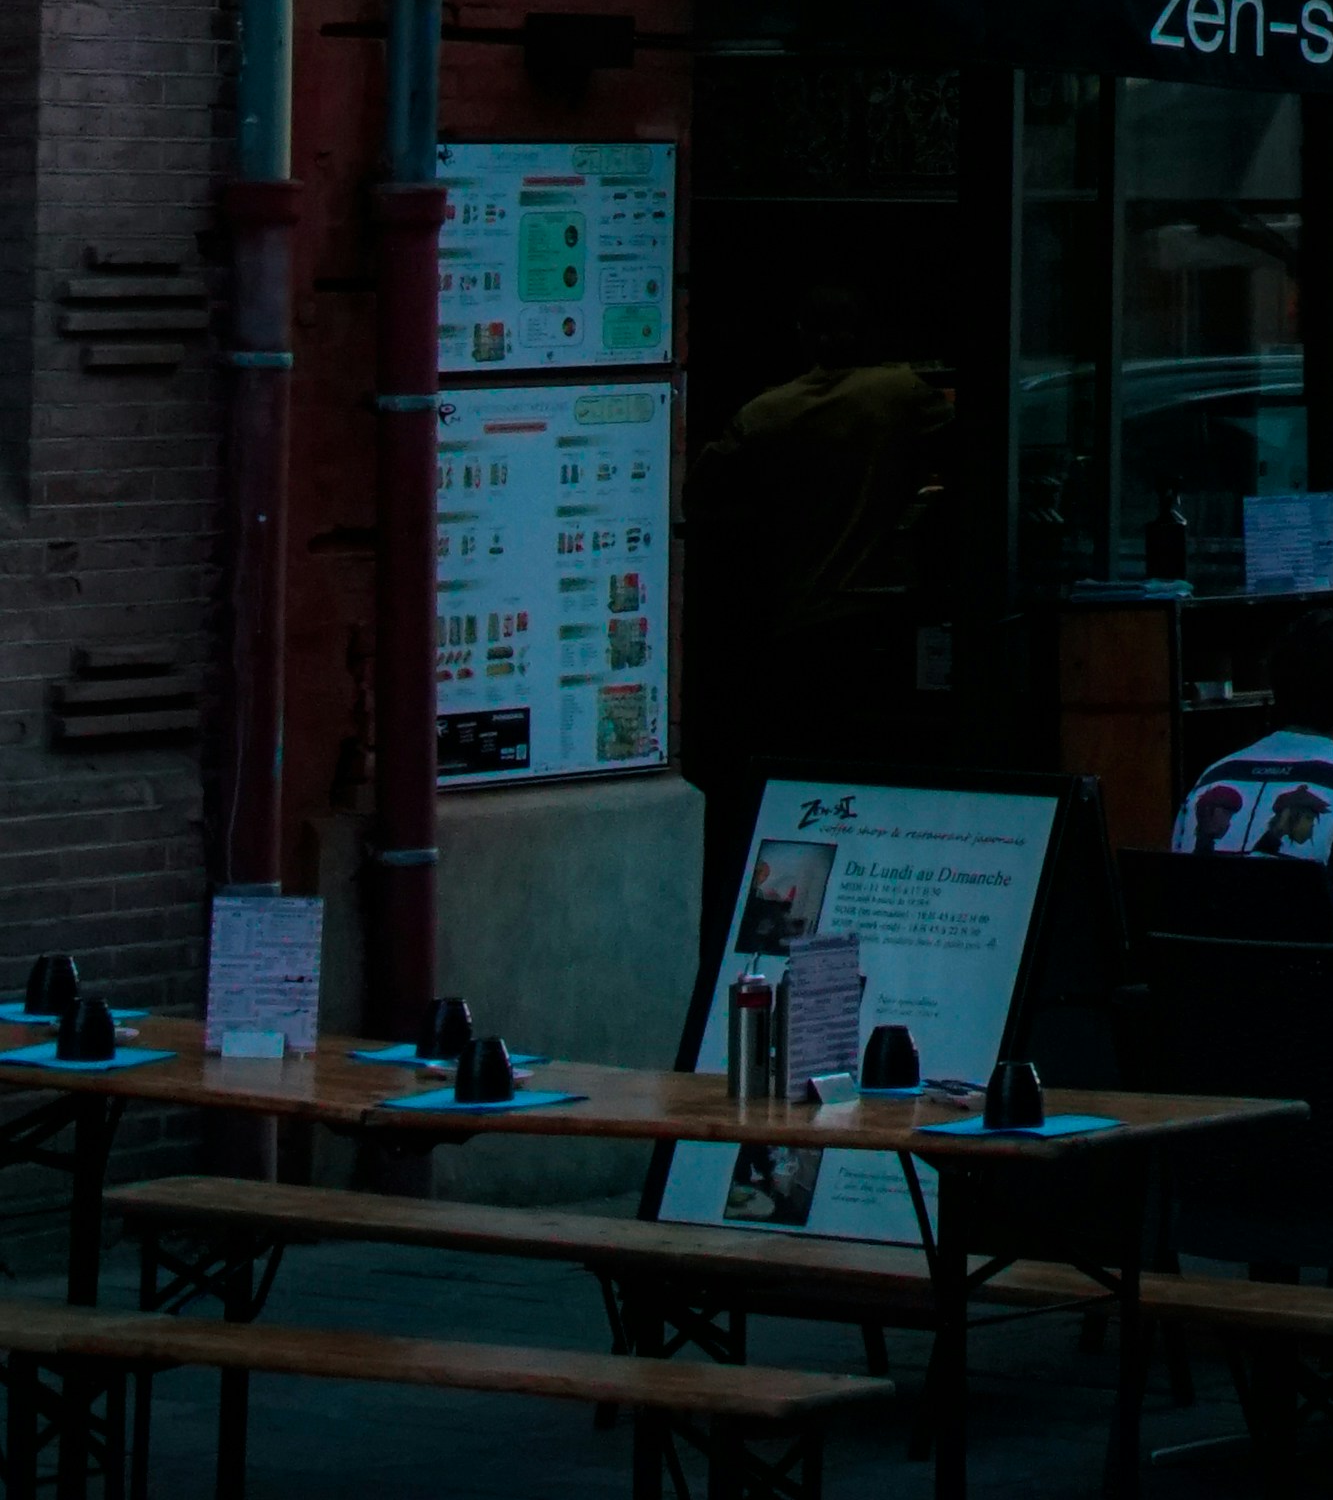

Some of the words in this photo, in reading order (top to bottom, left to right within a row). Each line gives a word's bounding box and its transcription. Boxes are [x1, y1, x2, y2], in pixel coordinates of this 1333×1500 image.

[844, 860, 866, 877] Du
[869, 862, 914, 882] Lundi
[915, 869, 935, 882] au
[937, 866, 1012, 887] Dimanche
